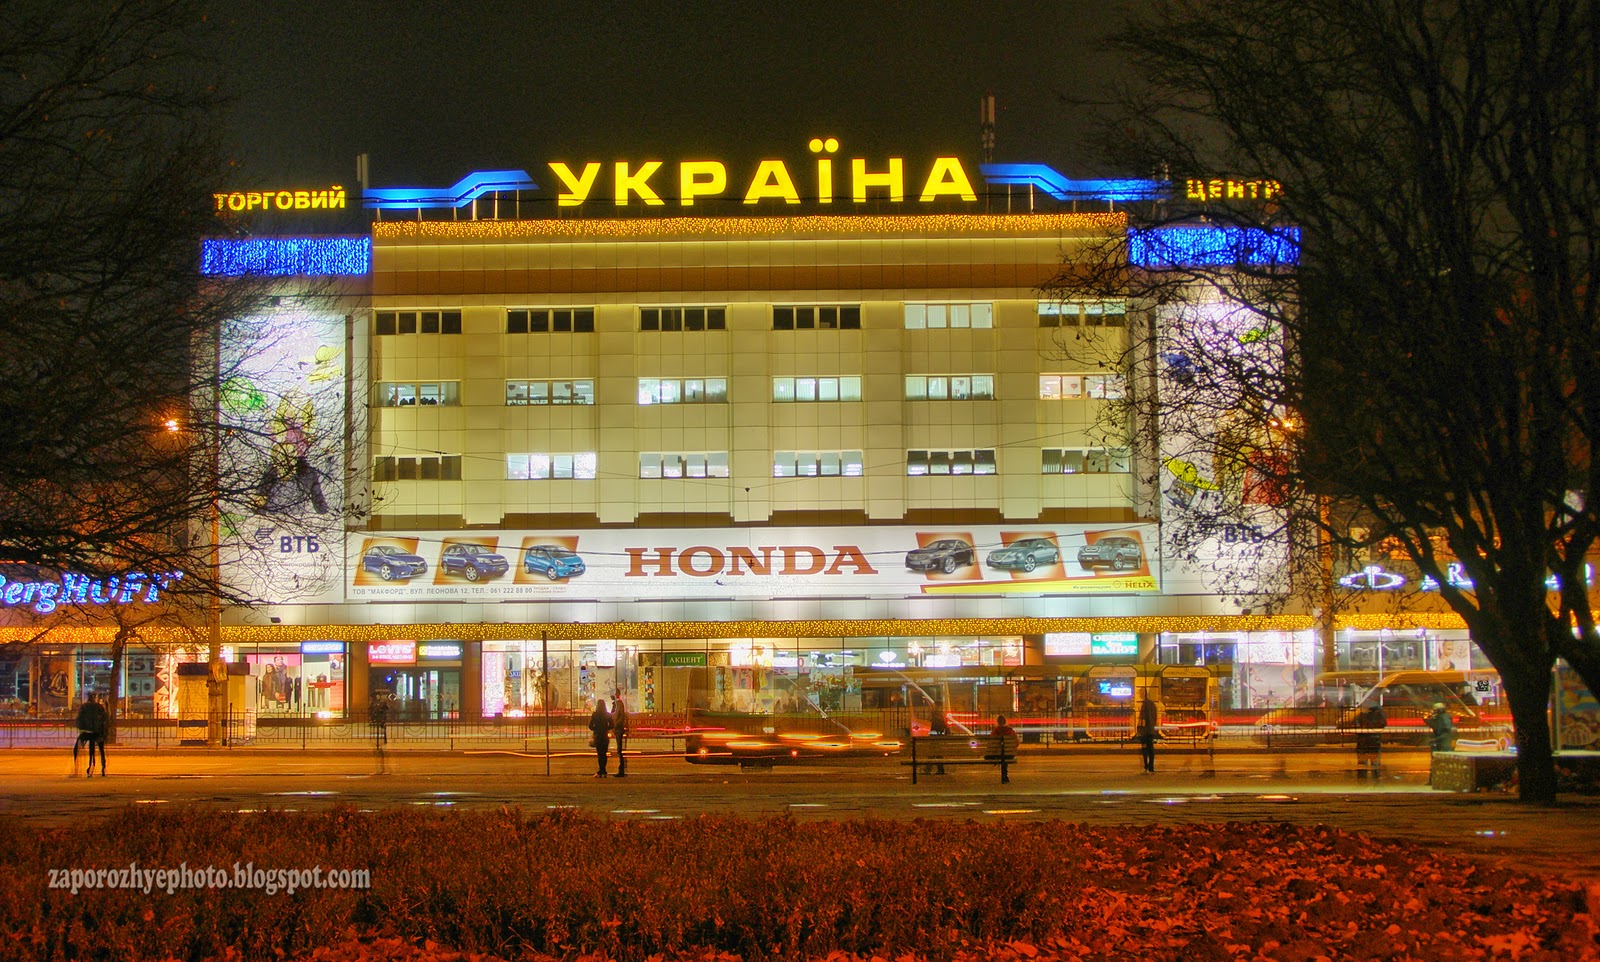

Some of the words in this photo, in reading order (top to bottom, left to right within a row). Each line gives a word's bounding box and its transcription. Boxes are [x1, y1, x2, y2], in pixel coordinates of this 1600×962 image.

[547, 138, 979, 206] УКРАЇНА
[213, 185, 345, 211] ТОРГОВИЙ
[1187, 180, 1281, 201] ЦЕНТР
[280, 536, 320, 553] ВТБ
[624, 545, 879, 577] HONDA
